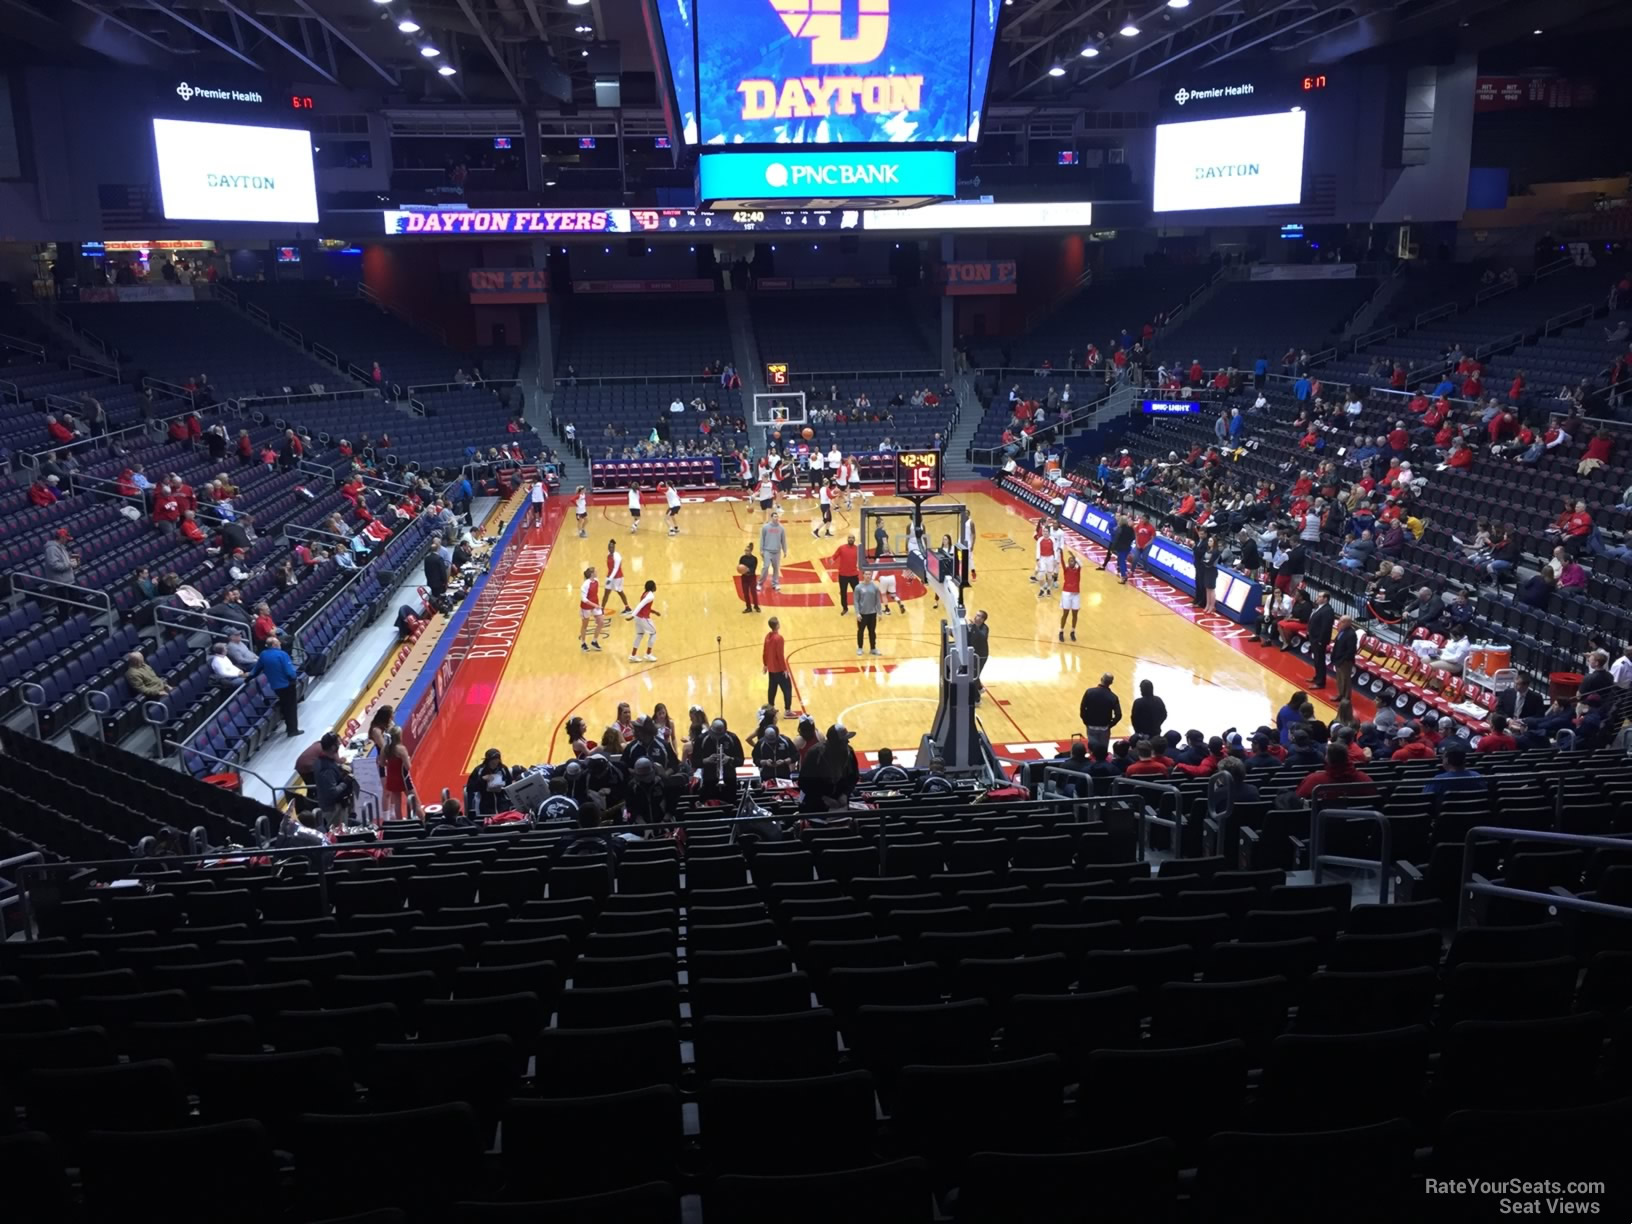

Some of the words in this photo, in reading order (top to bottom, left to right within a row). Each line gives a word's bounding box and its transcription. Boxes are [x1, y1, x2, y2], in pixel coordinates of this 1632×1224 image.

[1304, 76, 1326, 89] 6:17
[194, 87, 231, 100] Premier
[232, 90, 263, 103] Health
[737, 75, 924, 120] DAYTON
[1190, 87, 1224, 100] Premier
[1225, 84, 1254, 96] Health
[1195, 163, 1260, 180] DAYTON
[207, 173, 275, 190] DAYTON
[406, 212, 511, 231] DAYTON
[513, 211, 608, 231] FLYERS
[669, 217, 677, 228] 0
[689, 218, 696, 227] 4
[705, 217, 712, 227] 0
[732, 211, 764, 222] 42:40
[785, 216, 792, 225] 0
[801, 216, 808, 225] 4
[819, 215, 826, 226] 0
[775, 371, 785, 383] 15
[900, 453, 935, 467] 42:40
[913, 467, 931, 489] 15
[466, 579, 537, 659] BLACKBURN
[510, 544, 551, 576] COURT
